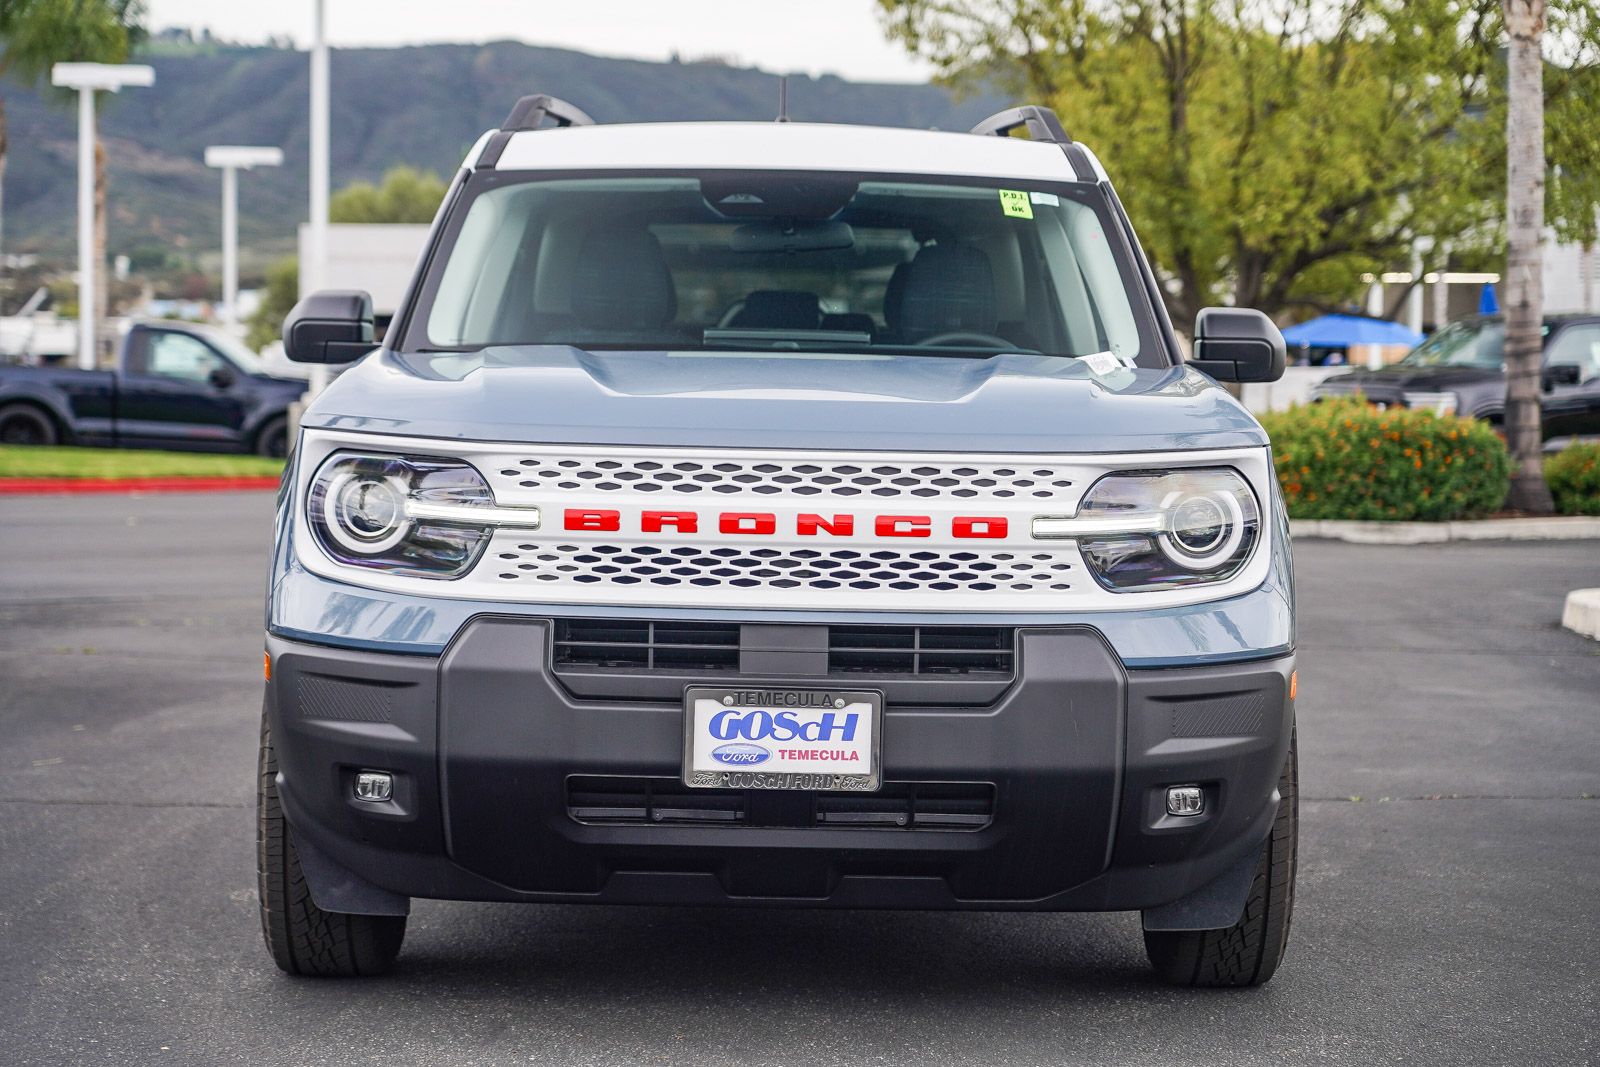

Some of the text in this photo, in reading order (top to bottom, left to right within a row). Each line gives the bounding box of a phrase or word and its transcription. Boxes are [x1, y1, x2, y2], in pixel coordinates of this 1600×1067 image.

[564, 508, 1009, 539] BRONCO
[733, 691, 833, 708] TEMECULA
[721, 744, 760, 763] Ford
[779, 749, 859, 761] TEMECULA
[790, 775, 834, 790] FORD
